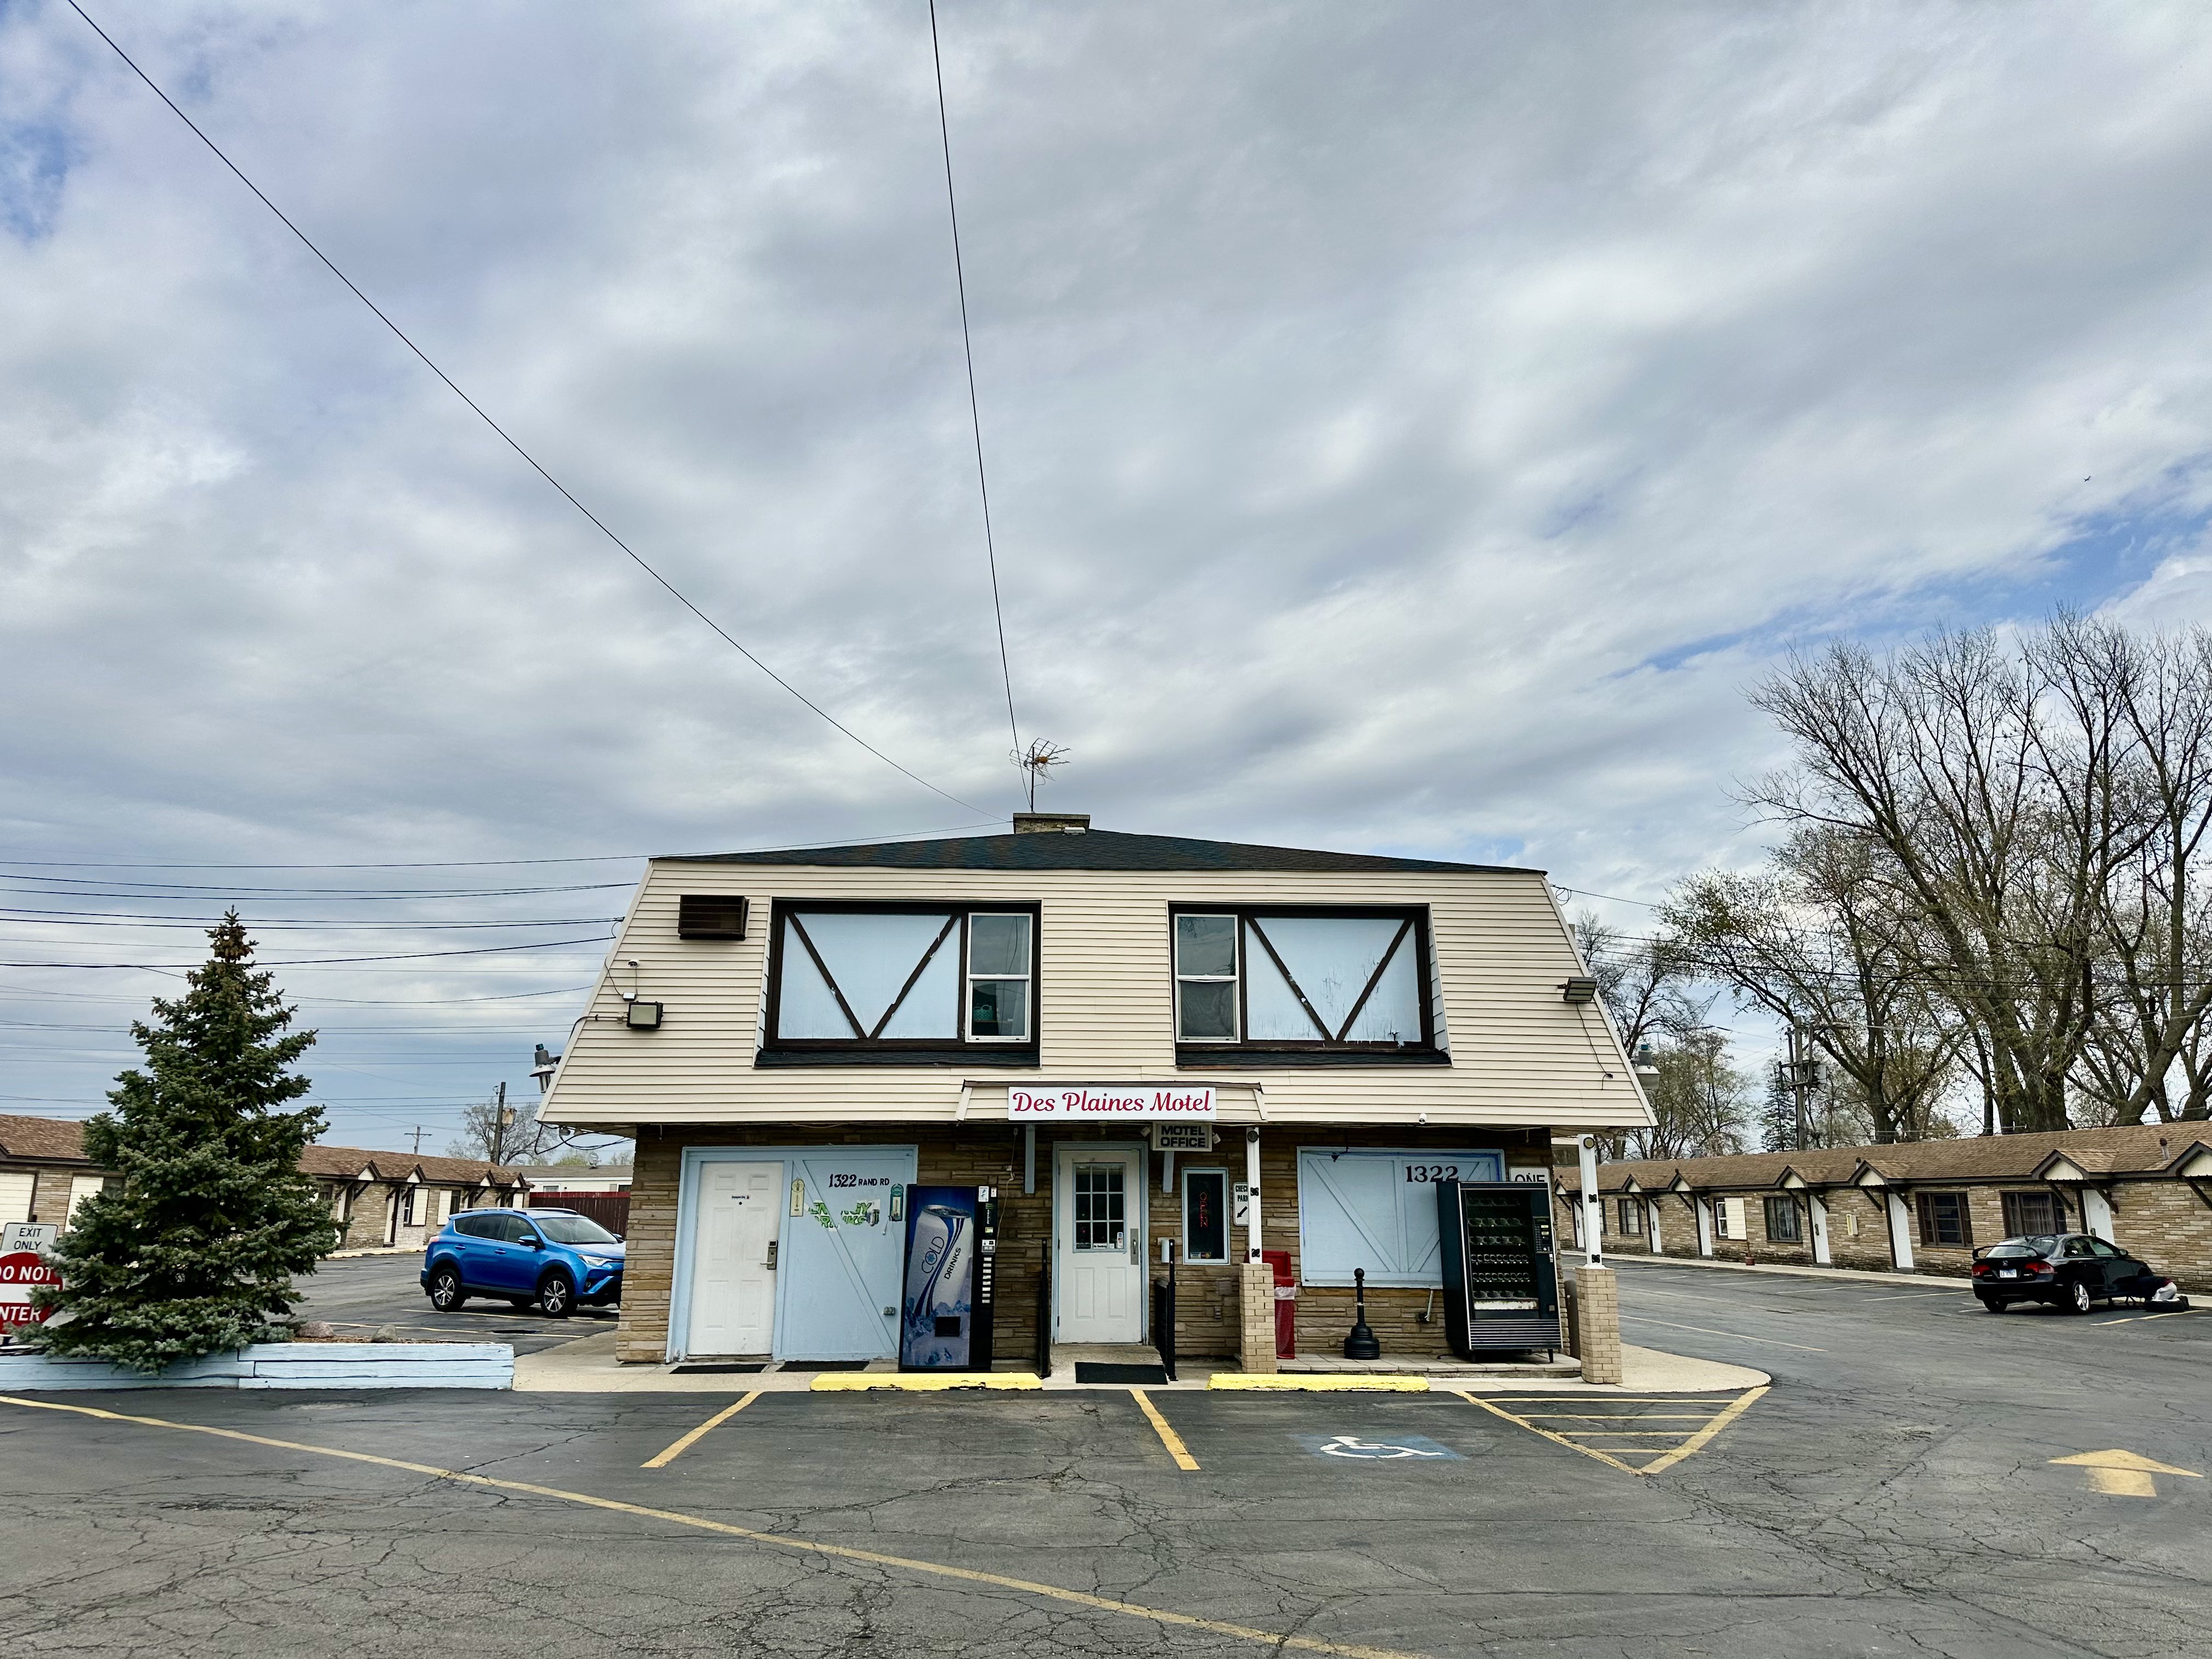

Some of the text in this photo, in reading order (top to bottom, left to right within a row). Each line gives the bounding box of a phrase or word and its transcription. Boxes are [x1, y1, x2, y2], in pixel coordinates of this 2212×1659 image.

[1013, 1090, 1212, 1112] Des Plaines Motel
[1161, 1125, 1205, 1136] MOTEL
[1160, 1137, 1206, 1148] OFFICE
[828, 1174, 857, 1188] 1322
[1406, 1165, 1459, 1183] 1322
[19, 1228, 43, 1237] EXIT
[14, 1240, 42, 1250] ONLY
[922, 1236, 945, 1273] COLD
[944, 1247, 961, 1280] DRINKS
[0, 1266, 54, 1281] O NOT
[0, 1306, 41, 1321] NTER
